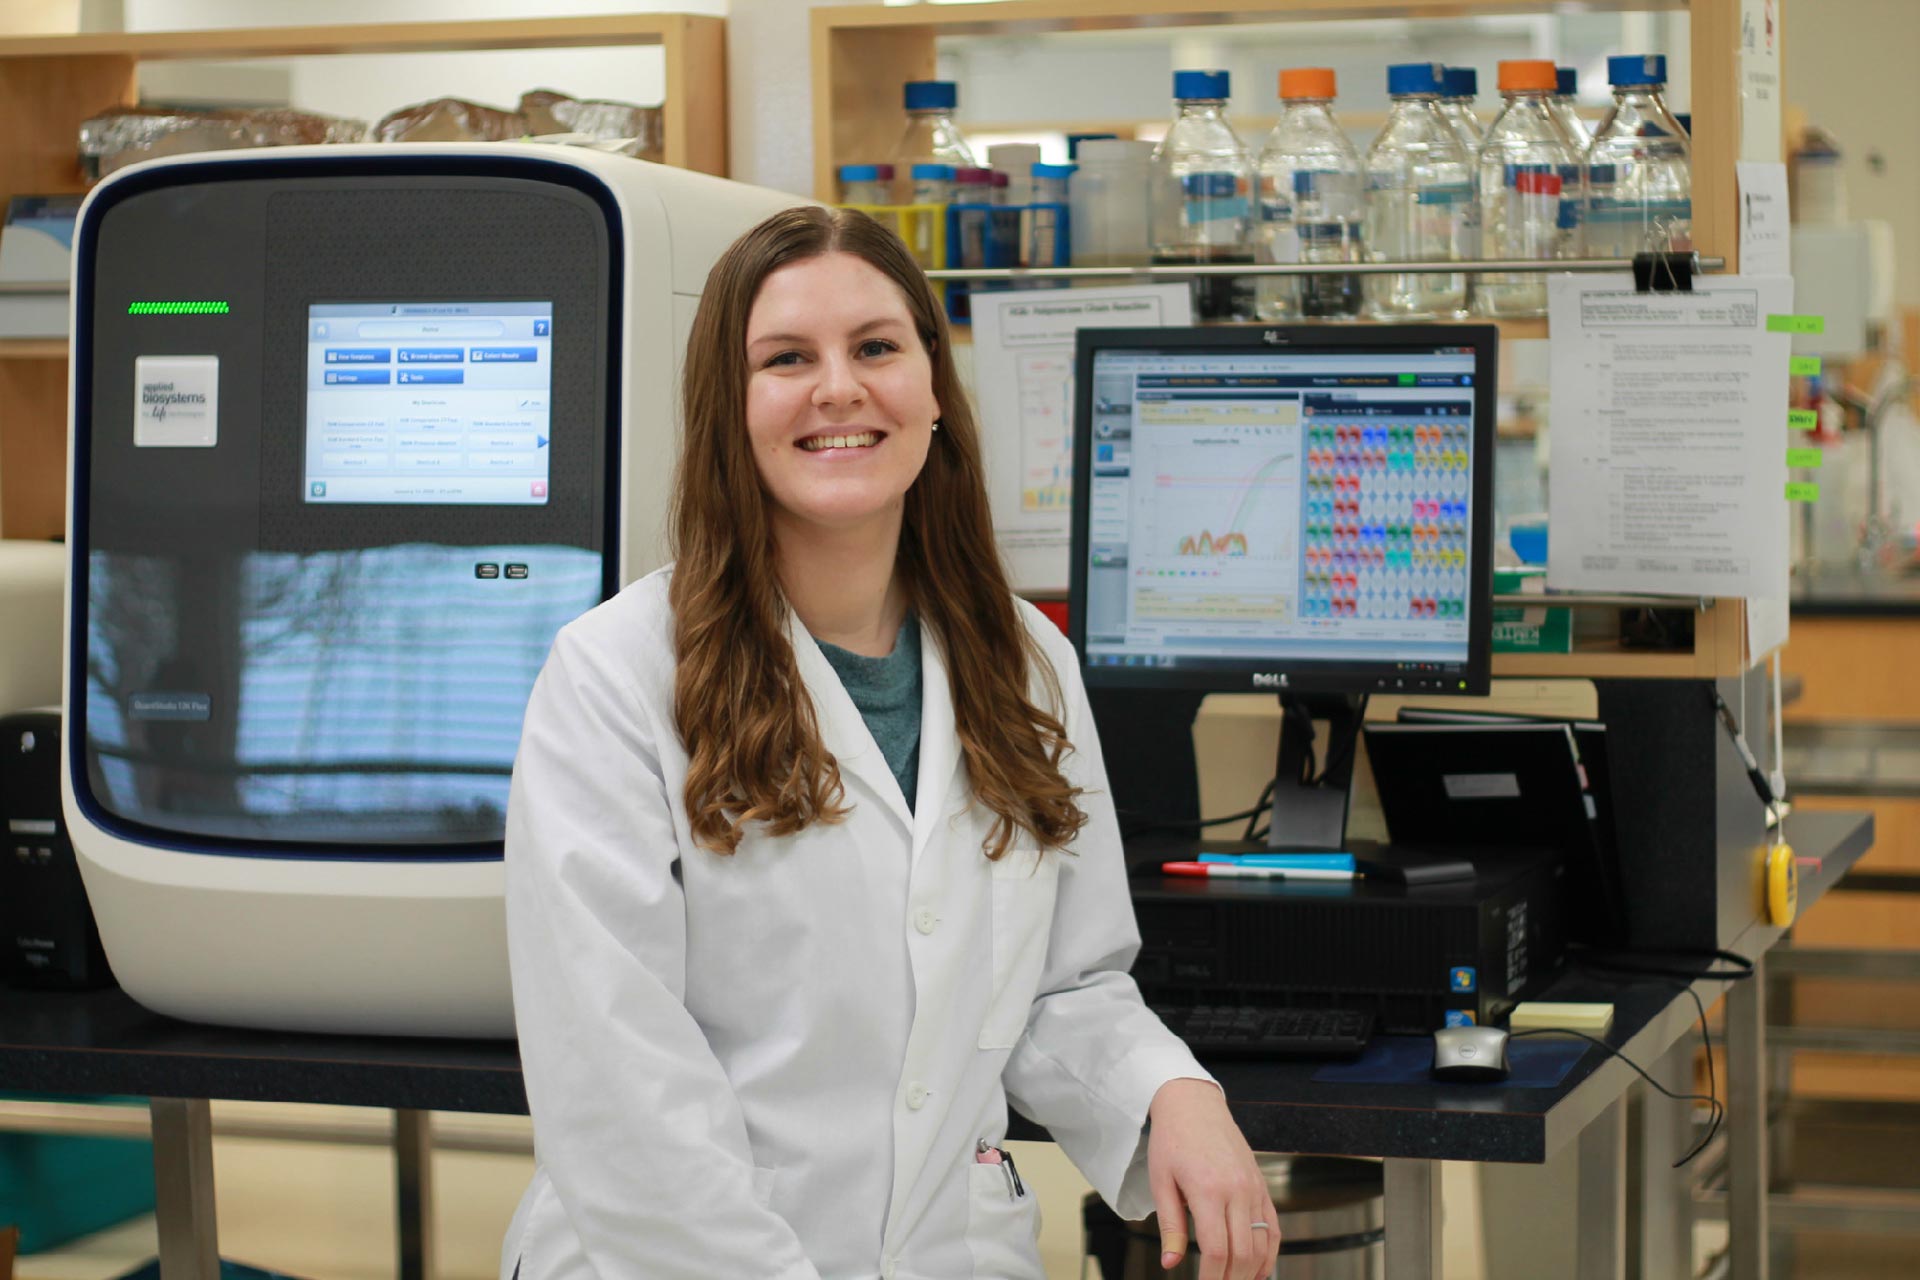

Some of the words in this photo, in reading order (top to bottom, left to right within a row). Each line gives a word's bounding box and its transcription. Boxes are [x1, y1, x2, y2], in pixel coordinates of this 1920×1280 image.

[143, 382, 174, 392] applied
[142, 391, 207, 405] biosystems
[1252, 672, 1289, 687] DELL
